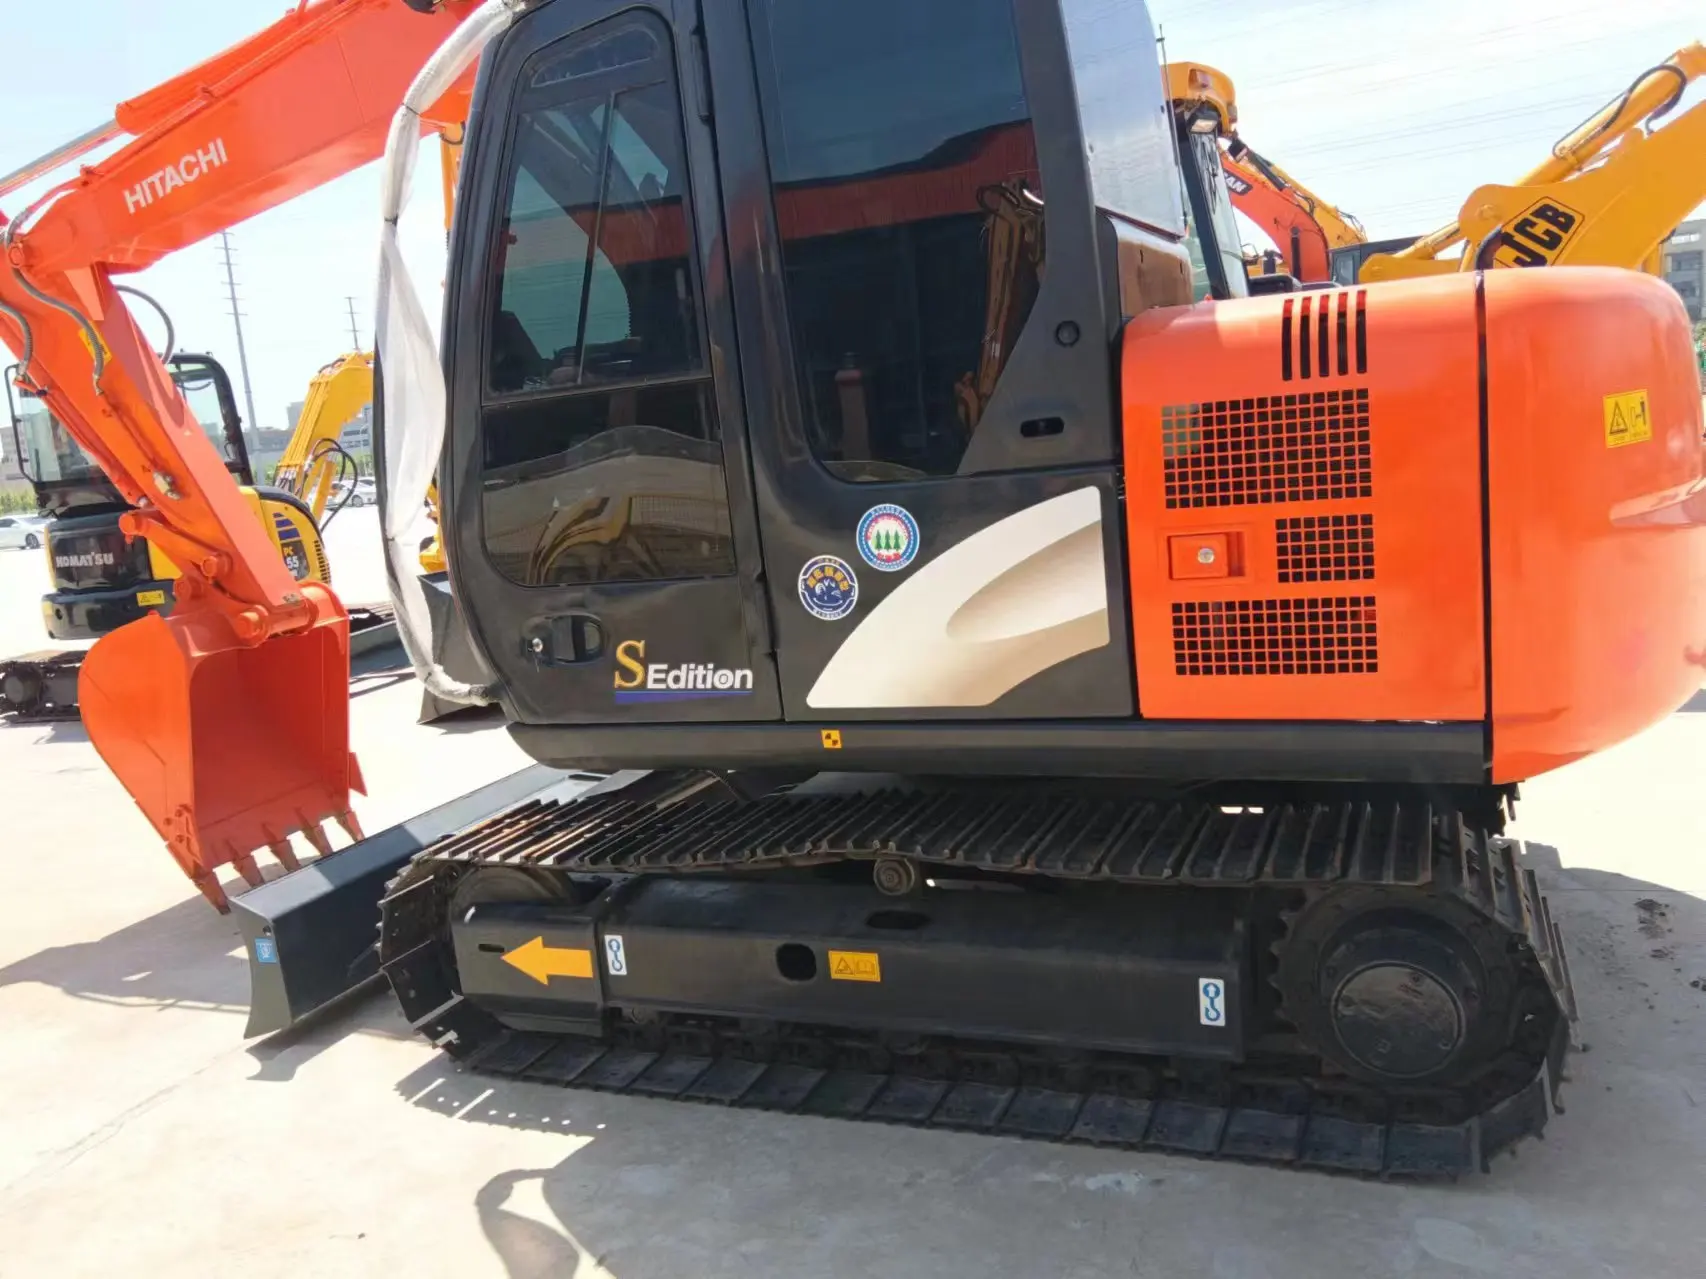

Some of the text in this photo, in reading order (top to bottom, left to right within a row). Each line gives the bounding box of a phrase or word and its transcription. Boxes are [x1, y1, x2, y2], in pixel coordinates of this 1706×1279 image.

[123, 137, 228, 215] HITACHI
[1224, 171, 1247, 193] AN
[1501, 203, 1576, 268] JCB
[55, 551, 114, 568] KOMATSU
[286, 555, 299, 569] 55
[614, 639, 753, 690] S Edition
